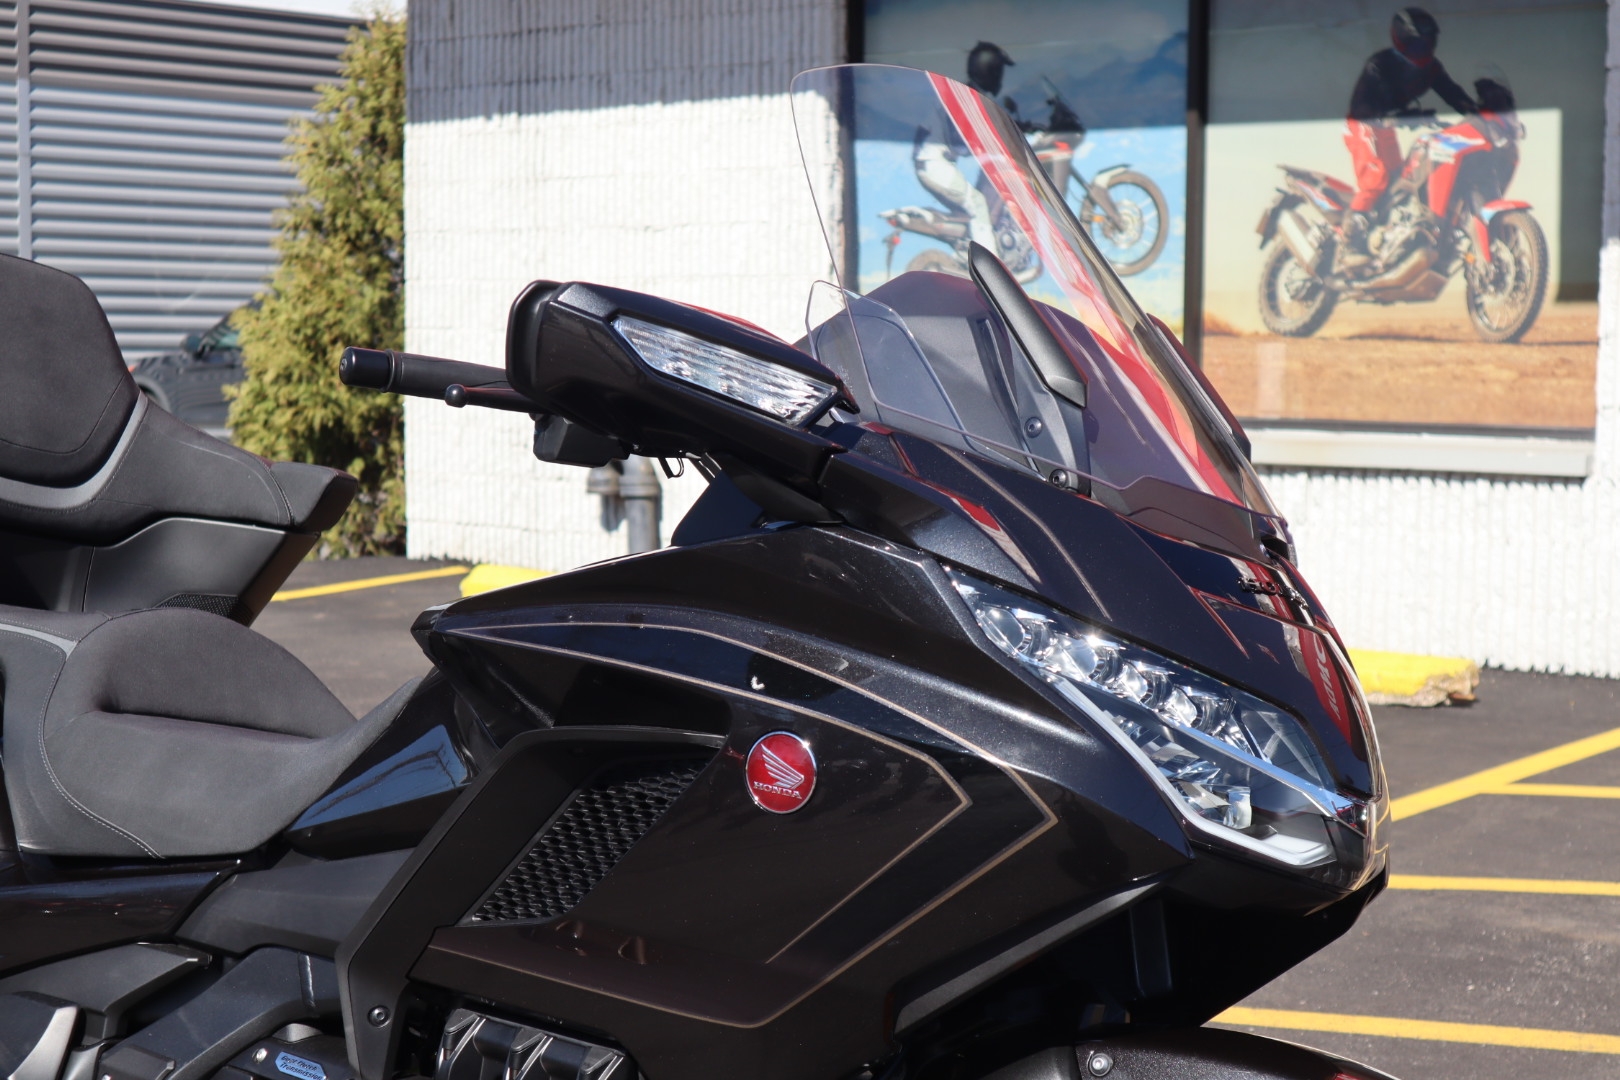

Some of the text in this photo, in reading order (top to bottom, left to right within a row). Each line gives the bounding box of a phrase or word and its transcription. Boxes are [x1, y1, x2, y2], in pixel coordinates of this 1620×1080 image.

[1237, 576, 1309, 611] HON
[753, 780, 802, 799] HONDA
[280, 1062, 323, 1080] Transmission
